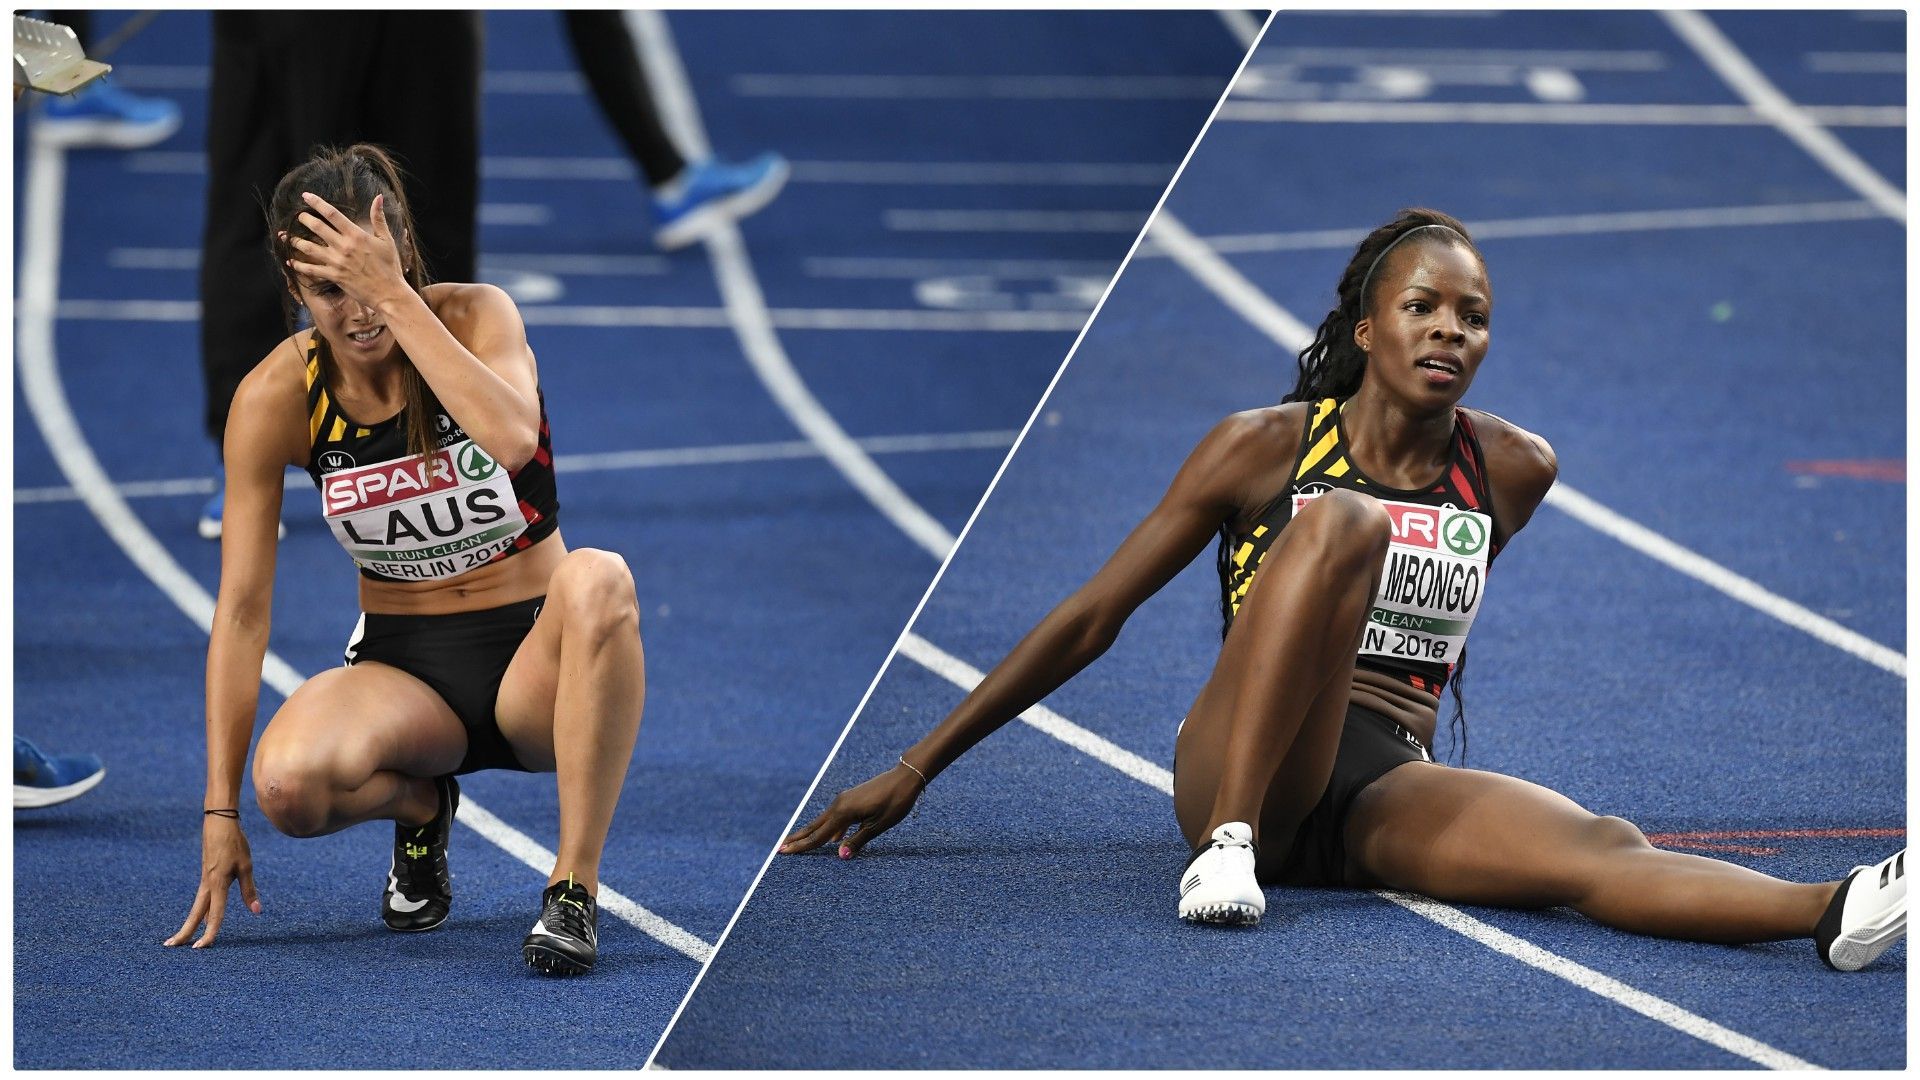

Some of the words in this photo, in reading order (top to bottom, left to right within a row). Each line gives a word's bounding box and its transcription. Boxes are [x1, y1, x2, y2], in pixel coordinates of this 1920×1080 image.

[328, 456, 453, 510] SPAR
[341, 488, 506, 546] LAUS
[372, 558, 457, 578] BERLIN
[461, 535, 516, 568] 2018
[386, 552, 392, 560] I
[396, 550, 429, 561] RUN
[1383, 552, 1479, 614] MBONGO
[1391, 633, 1449, 659] 2018
